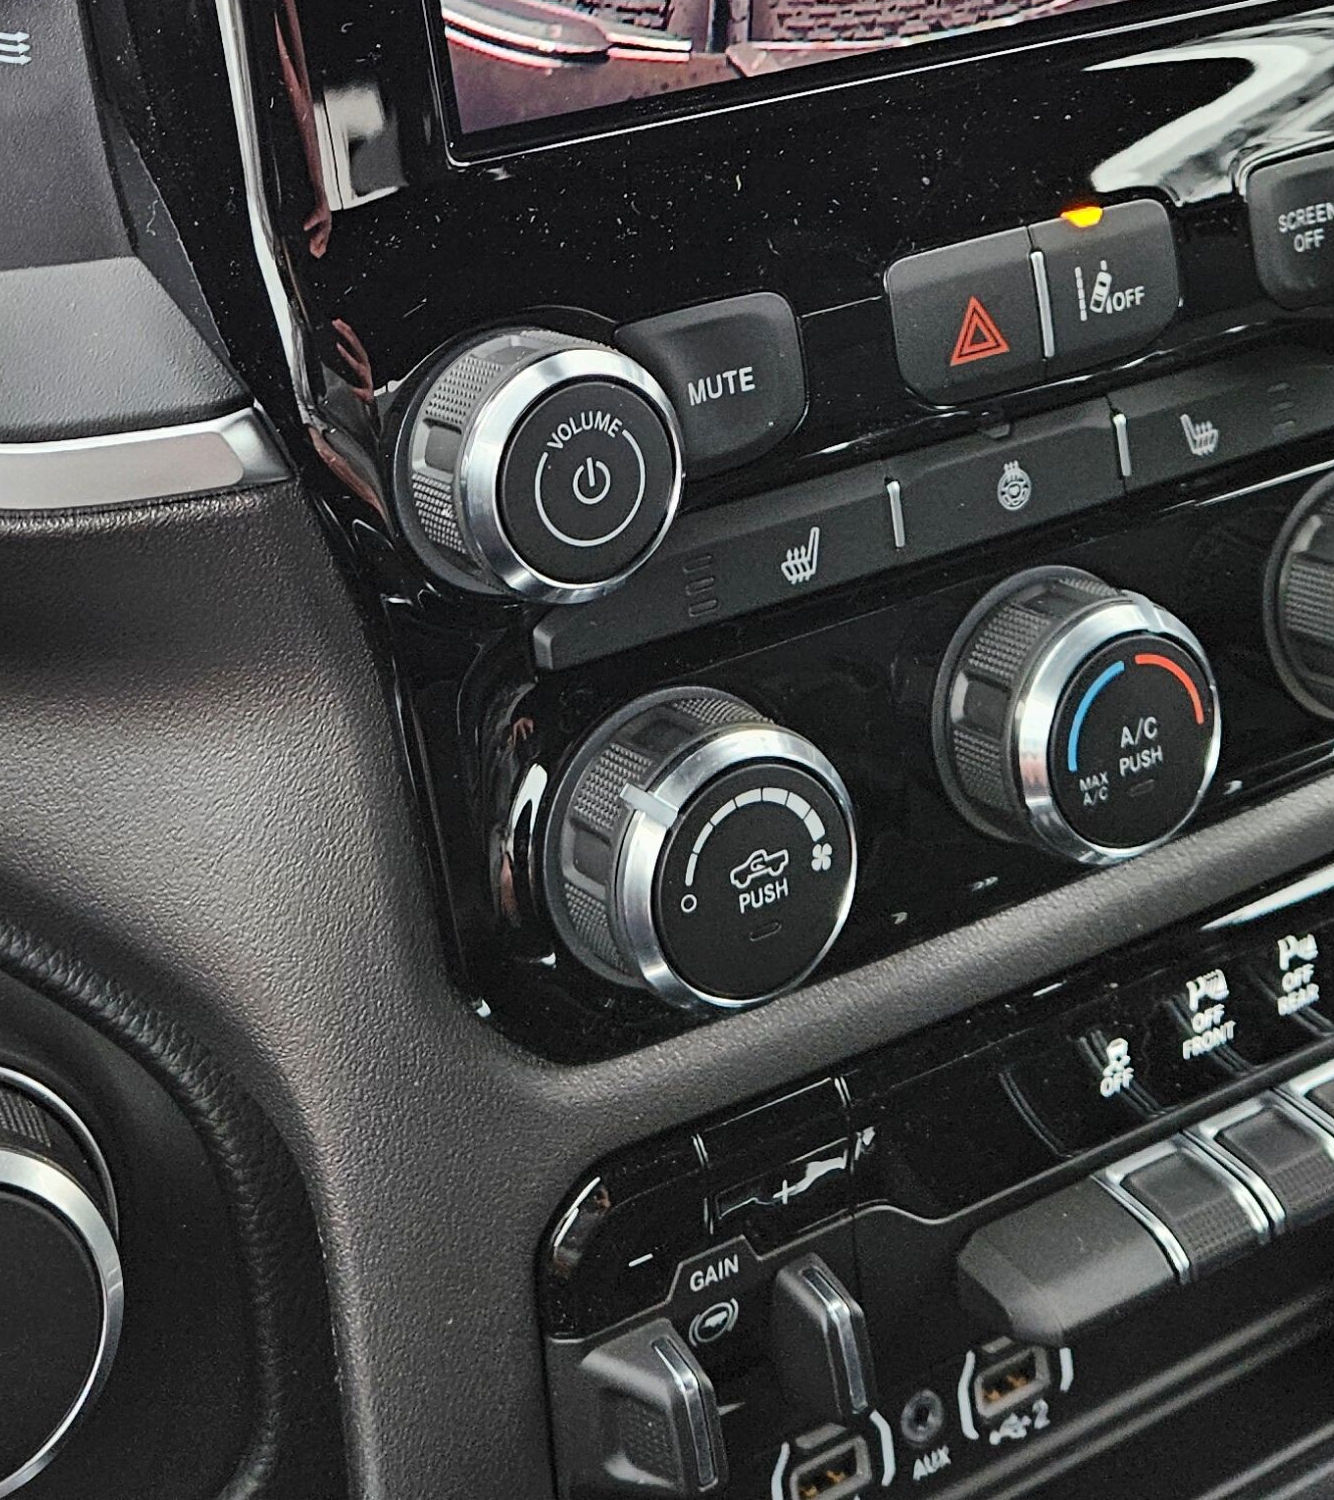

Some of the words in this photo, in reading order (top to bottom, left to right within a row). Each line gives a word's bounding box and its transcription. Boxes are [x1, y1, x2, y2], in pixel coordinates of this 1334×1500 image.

[1293, 223, 1326, 253] OFF
[1113, 284, 1145, 311] OFF
[687, 367, 756, 406] MUTE
[547, 411, 623, 452] VOLUME
[1121, 716, 1158, 749] A/C
[1119, 745, 1163, 778] PUSH
[1079, 772, 1109, 794] MAX
[1083, 786, 1109, 807] A/C
[738, 879, 790, 913] PUSH
[1282, 964, 1314, 993] OFF
[1192, 1003, 1224, 1034] OFF
[1183, 1020, 1236, 1060] FRONT
[1100, 1068, 1133, 1098] OFF
[689, 1255, 740, 1292] GAIN
